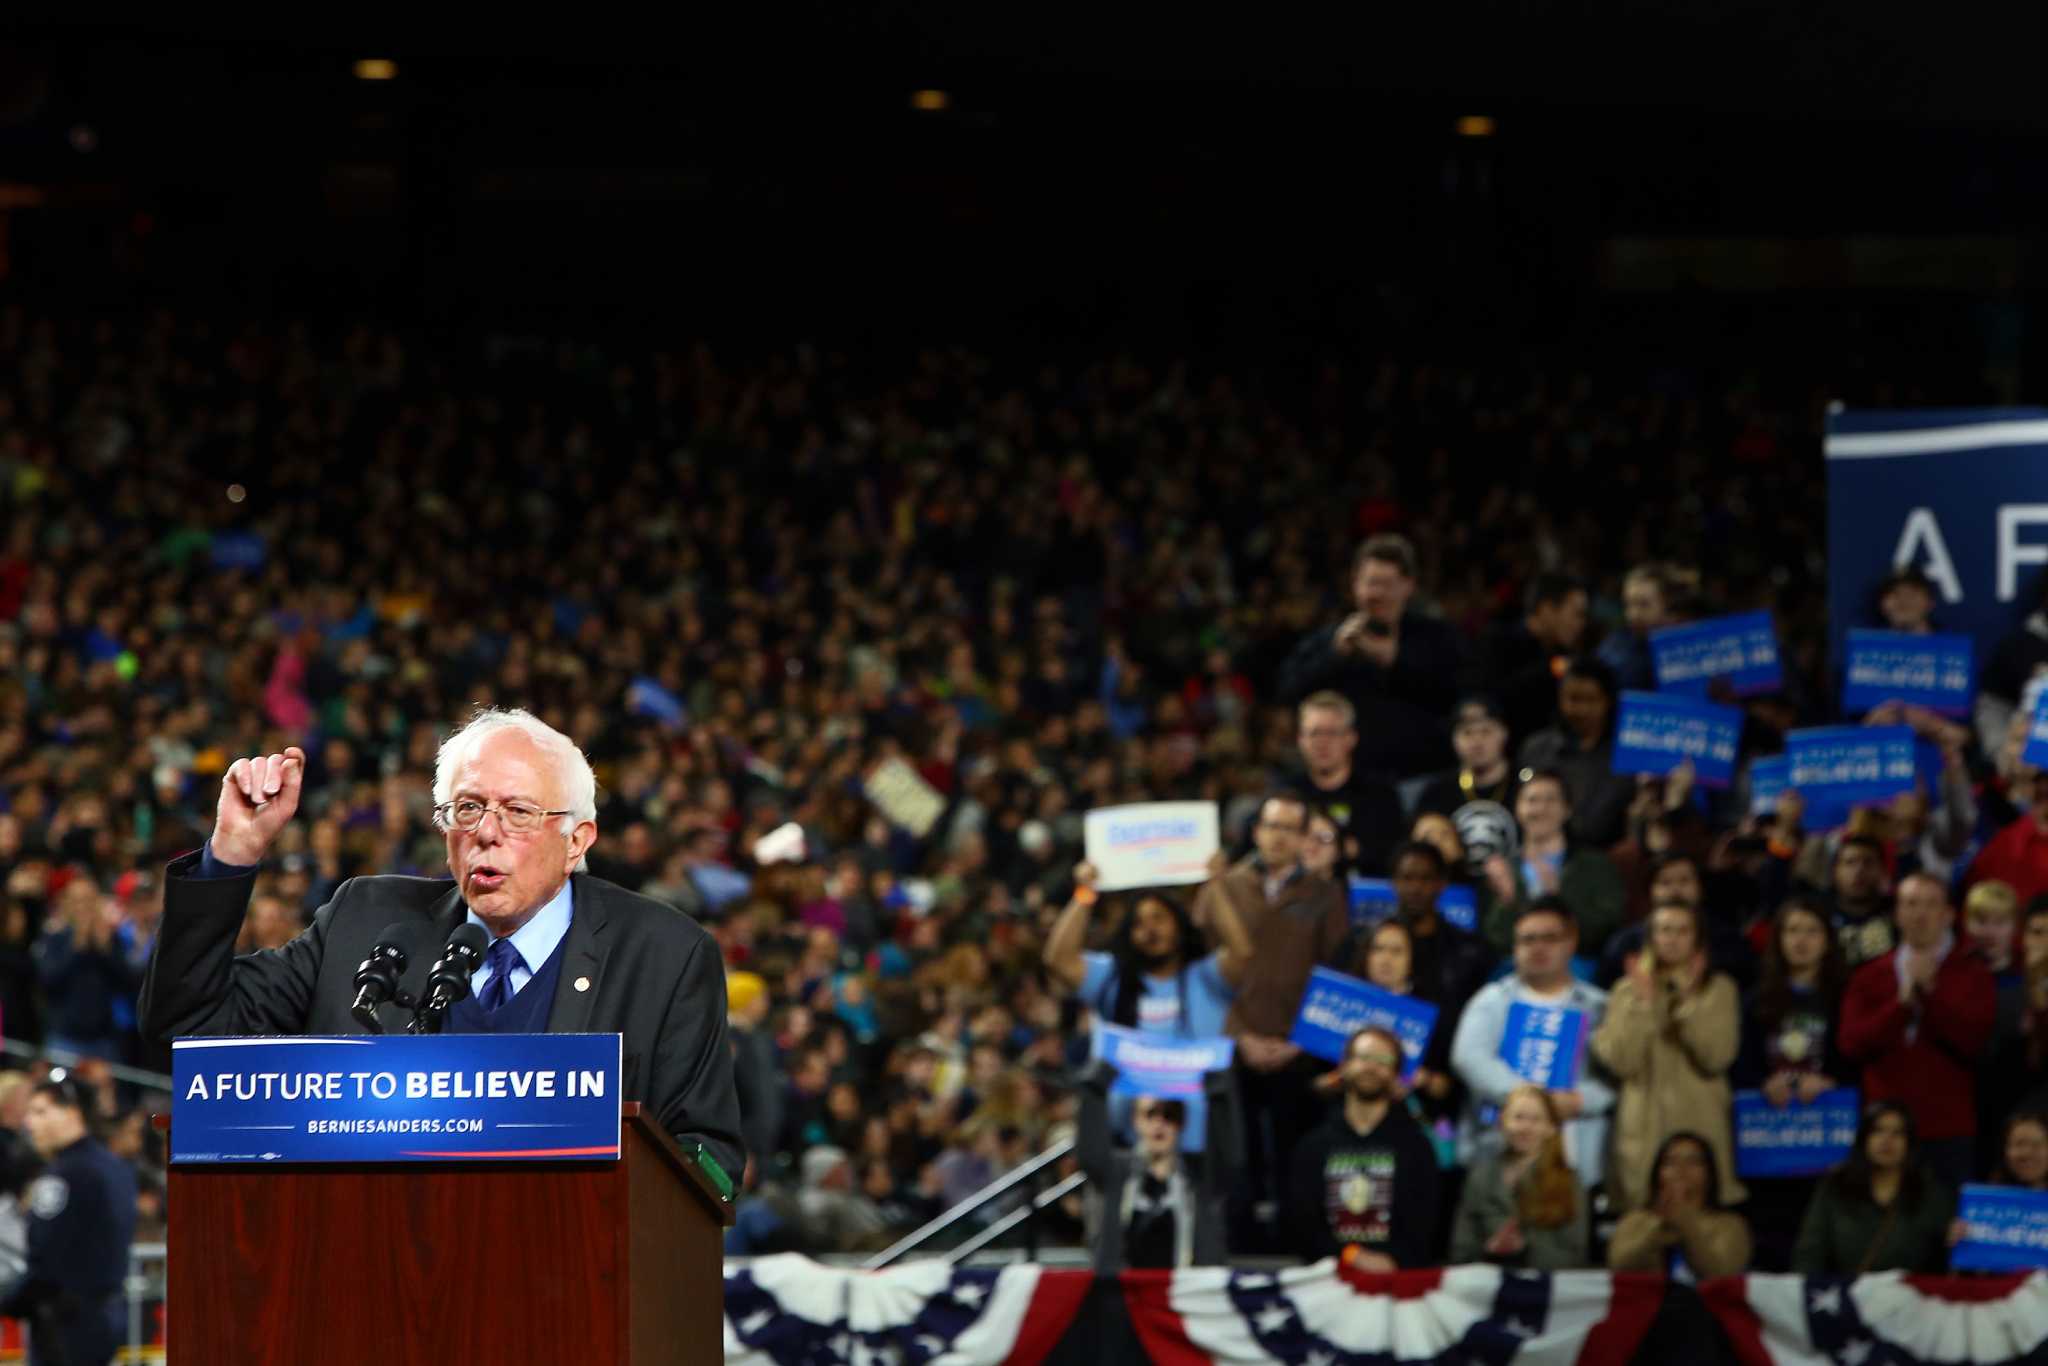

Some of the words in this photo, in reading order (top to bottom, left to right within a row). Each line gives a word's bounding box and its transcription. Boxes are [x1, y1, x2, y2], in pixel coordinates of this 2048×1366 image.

[1893, 507, 1962, 602] A
[186, 1074, 209, 1100] A
[216, 1072, 343, 1100] FUTURE
[347, 1072, 397, 1099] TO
[406, 1071, 556, 1098] BELIEVE
[567, 1070, 605, 1097] IN
[307, 1118, 484, 1134] BERNIESANDERS.COM
